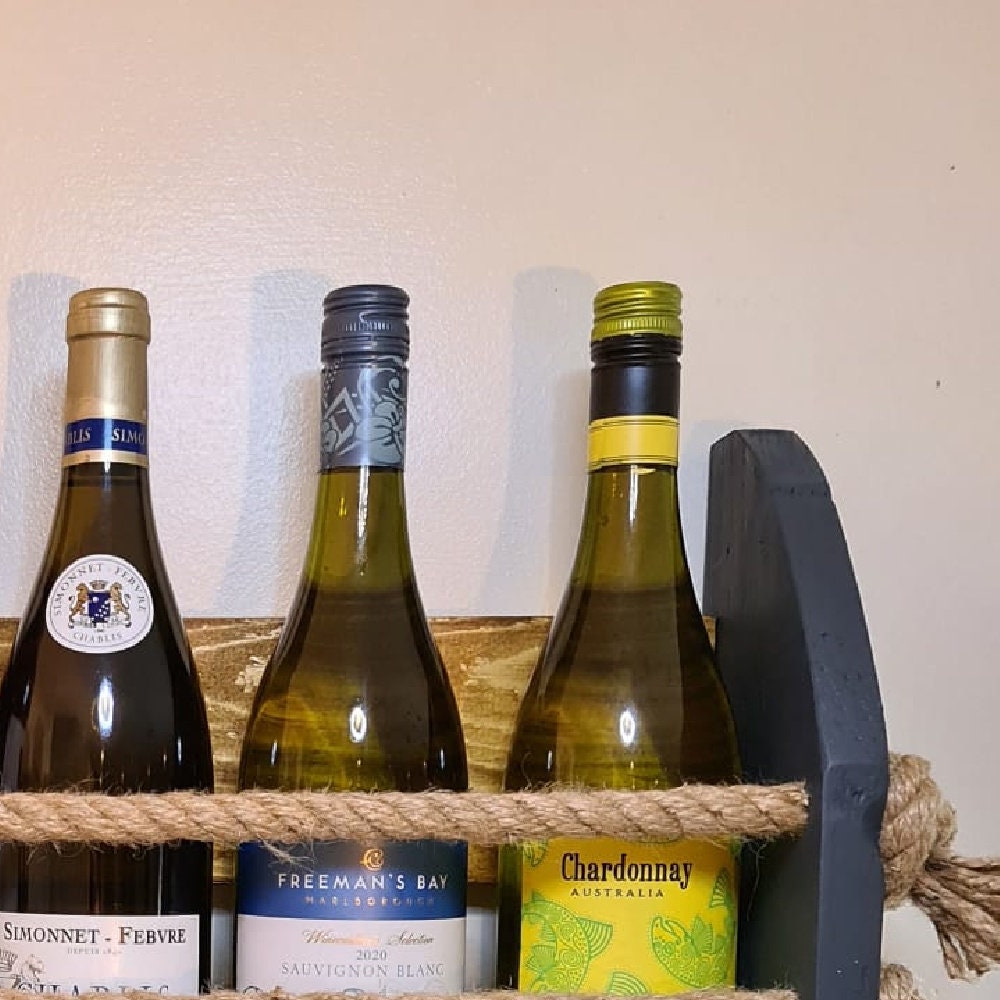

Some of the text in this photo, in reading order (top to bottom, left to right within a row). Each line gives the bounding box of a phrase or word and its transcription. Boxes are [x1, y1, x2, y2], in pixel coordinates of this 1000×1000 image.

[561, 852, 693, 889] Chardonnay
[277, 873, 449, 890] FREEMAN'S BAY
[570, 888, 665, 898] AUSTRALIA
[3, 921, 101, 944] SIMONNET
[118, 925, 187, 945] FEBVRE
[355, 949, 388, 961] 2020
[280, 962, 446, 979] SAUVIGNON BLANC
